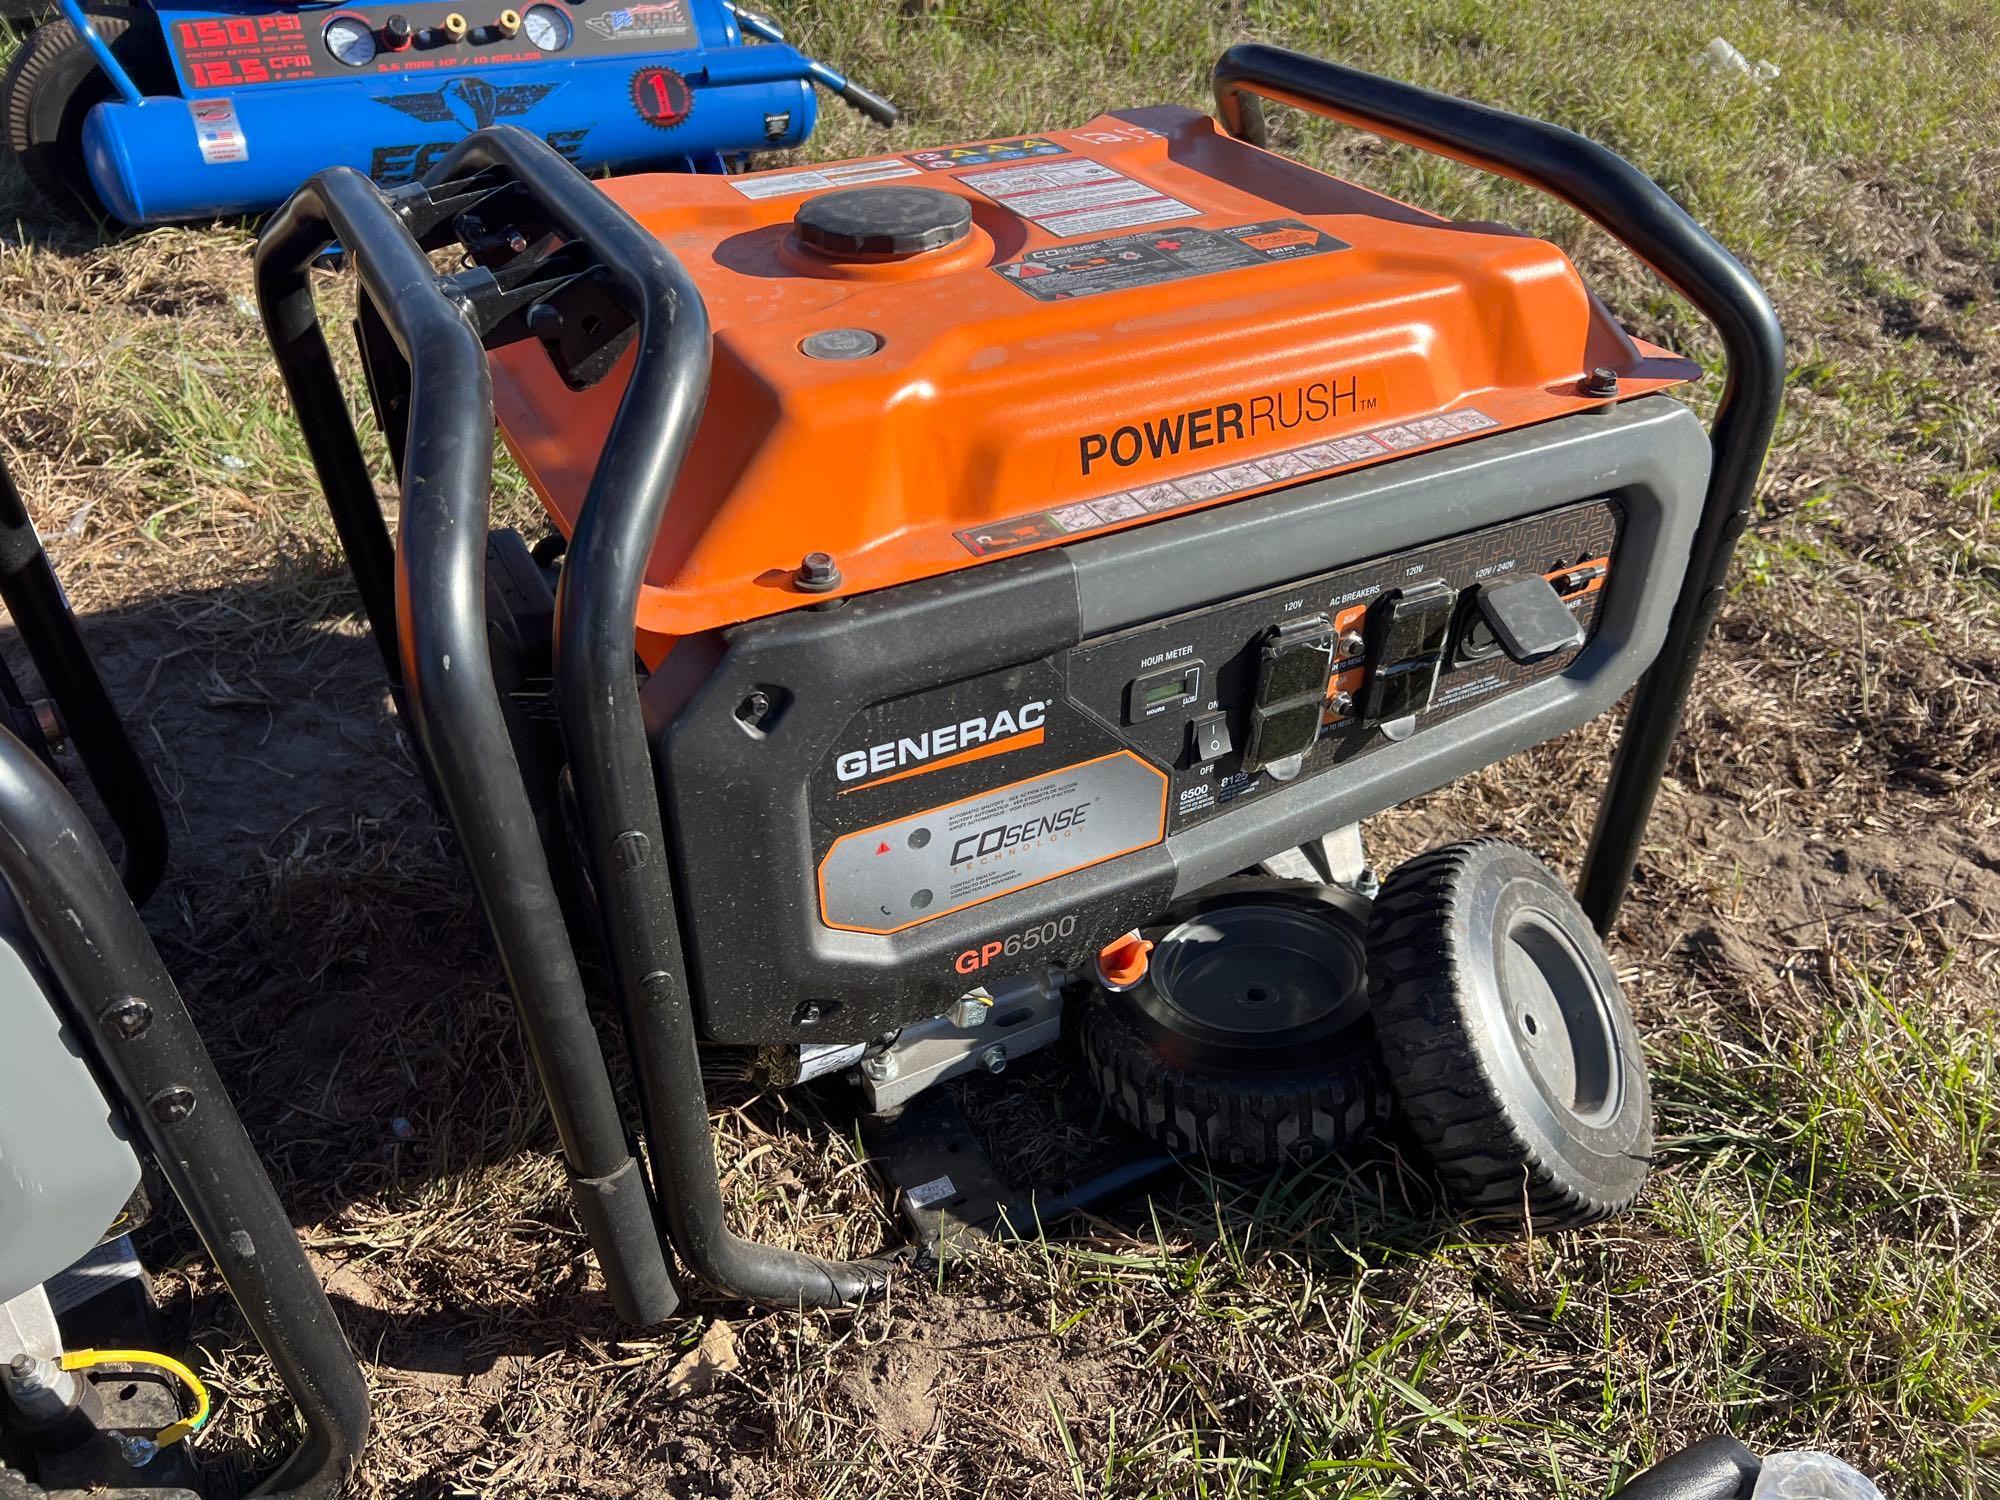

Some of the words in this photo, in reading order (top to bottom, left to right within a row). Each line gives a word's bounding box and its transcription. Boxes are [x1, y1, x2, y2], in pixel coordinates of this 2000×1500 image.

[178, 18, 258, 49] 150
[258, 15, 301, 32] PSI
[404, 60, 435, 70] MAX
[439, 58, 456, 67] HP
[492, 52, 541, 64] GALLON
[190, 58, 270, 88] 12.5
[268, 54, 312, 69] CFM
[1405, 564, 1425, 576] 120V
[1497, 559, 1515, 572] 240V
[1329, 596, 1341, 607] AC
[1342, 584, 1381, 603] BREAKERS
[1283, 599, 1304, 612] 120V
[1141, 653, 1164, 668] HOUR
[1165, 645, 1193, 661] METER
[1207, 700, 1219, 711] ON
[836, 701, 1046, 782] GENERAC
[1200, 764, 1215, 776] OFF
[1220, 771, 1249, 788] 8125
[948, 807, 980, 821] AUTOMATIC
[980, 799, 1005, 812] SHUTOFF
[1020, 788, 1041, 799] ACTION
[1041, 783, 1056, 793] LABEL
[1180, 784, 1209, 801] 6500
[950, 802, 1091, 866] COSENSE
[951, 826, 1085, 874] TECHNOLOGY
[950, 878, 975, 890] CONTACT
[975, 871, 996, 881] DEALER
[950, 882, 979, 895] CONTACTO
[955, 915, 1076, 975] GP6500
